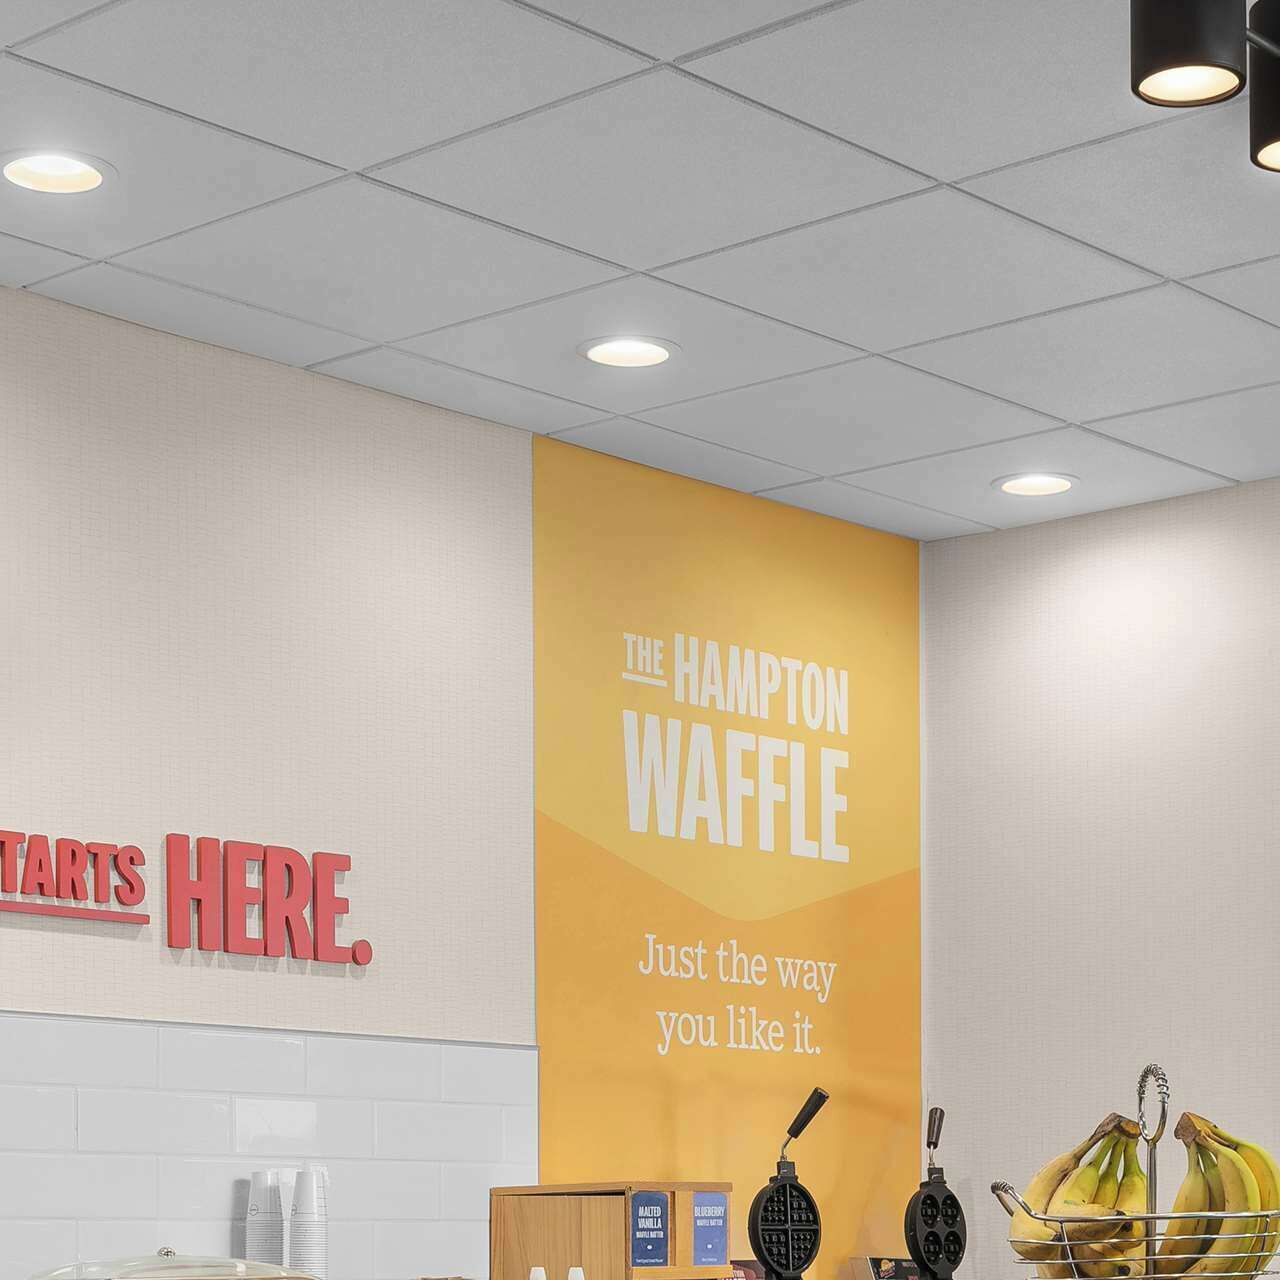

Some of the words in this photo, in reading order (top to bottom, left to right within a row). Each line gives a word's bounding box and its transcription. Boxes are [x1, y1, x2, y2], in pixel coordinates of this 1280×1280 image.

[623, 632, 664, 676] THE
[674, 632, 849, 736] HAMPTON
[622, 708, 850, 864] WAFFLE
[165, 832, 373, 967] HERE.
[638, 933, 709, 981] Just
[715, 938, 768, 987] the
[773, 956, 838, 1004] way
[655, 1010, 719, 1056] you
[725, 1004, 785, 1052] like
[792, 1009, 822, 1055] it.
[637, 1218, 662, 1229] VANILLA
[638, 1206, 662, 1217] MALTED
[694, 1206, 725, 1217] BLUEBERRY
